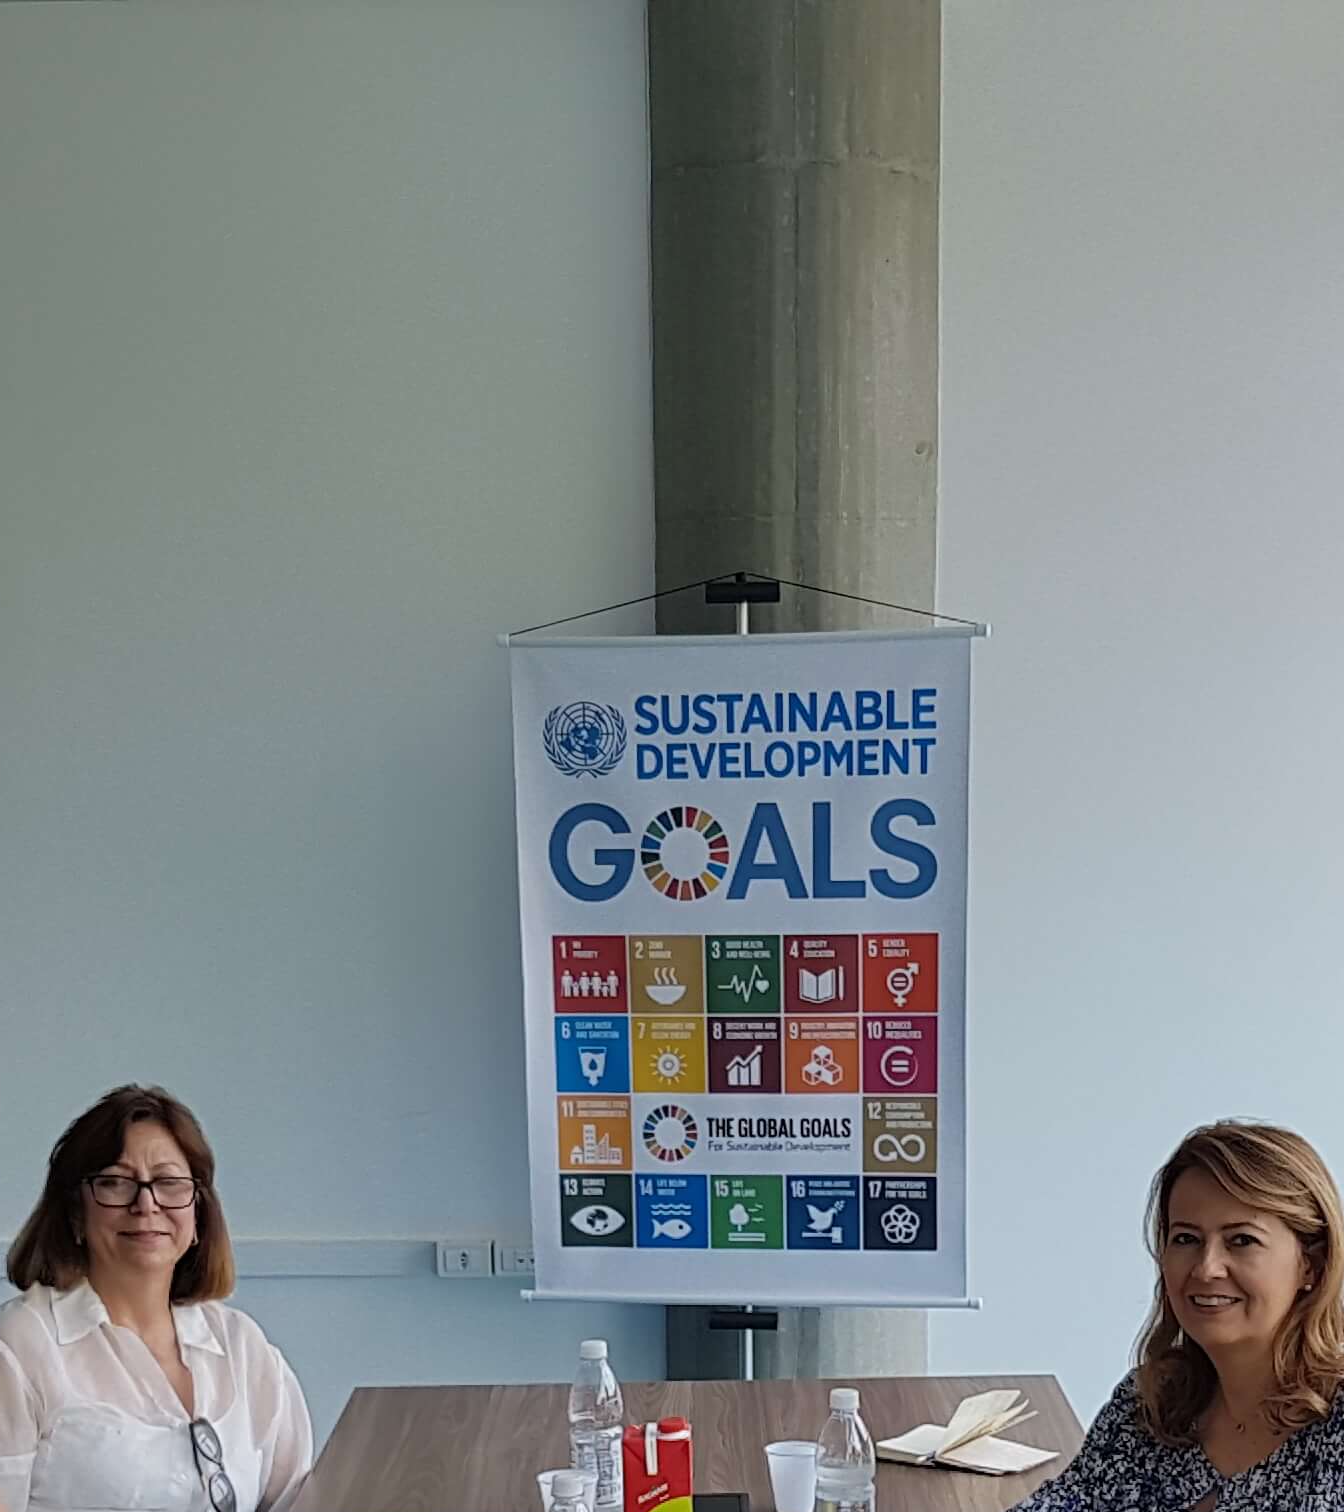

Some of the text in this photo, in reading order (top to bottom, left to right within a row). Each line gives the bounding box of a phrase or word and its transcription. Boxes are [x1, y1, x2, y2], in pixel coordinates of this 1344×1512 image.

[634, 688, 938, 736] SUSTAINABLE
[636, 738, 937, 780] DEVELOPMENT
[548, 798, 939, 902] GOALS
[560, 941, 567, 959] 1
[635, 941, 644, 959] 2
[711, 941, 721, 959] 3
[789, 940, 799, 958] 4
[867, 939, 877, 957] 5
[561, 1022, 571, 1039] 6
[637, 1022, 646, 1039] 7
[712, 1022, 722, 1039] 8
[789, 1022, 798, 1039] 9
[867, 1021, 882, 1039] 10
[561, 1101, 574, 1117] 11
[867, 1102, 881, 1119] 12
[707, 1117, 852, 1138] THE GLOBAL GOALS
[563, 1178, 578, 1196] 13
[639, 1179, 653, 1196] 14
[714, 1179, 729, 1197] 15
[791, 1180, 806, 1197] 16
[868, 1180, 882, 1198] 17
